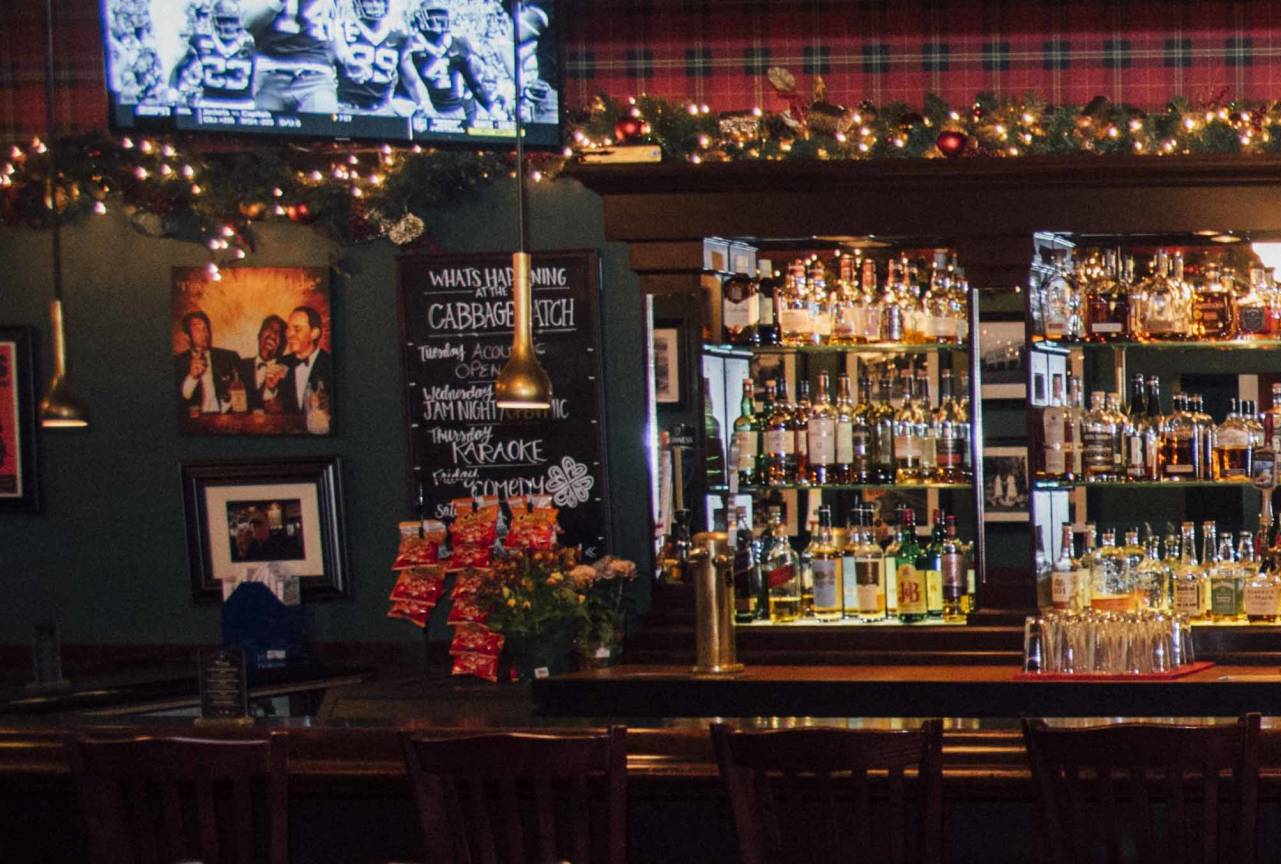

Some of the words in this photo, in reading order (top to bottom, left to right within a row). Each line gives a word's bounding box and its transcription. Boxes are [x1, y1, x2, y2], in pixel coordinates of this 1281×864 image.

[428, 268, 481, 288] WHATS
[484, 267, 568, 288] HAPNING
[490, 286, 508, 297] THE
[532, 298, 575, 327] ATCH
[423, 399, 454, 421] JAM
[456, 399, 498, 421] NIGHT
[452, 438, 548, 465] KARAOKE
